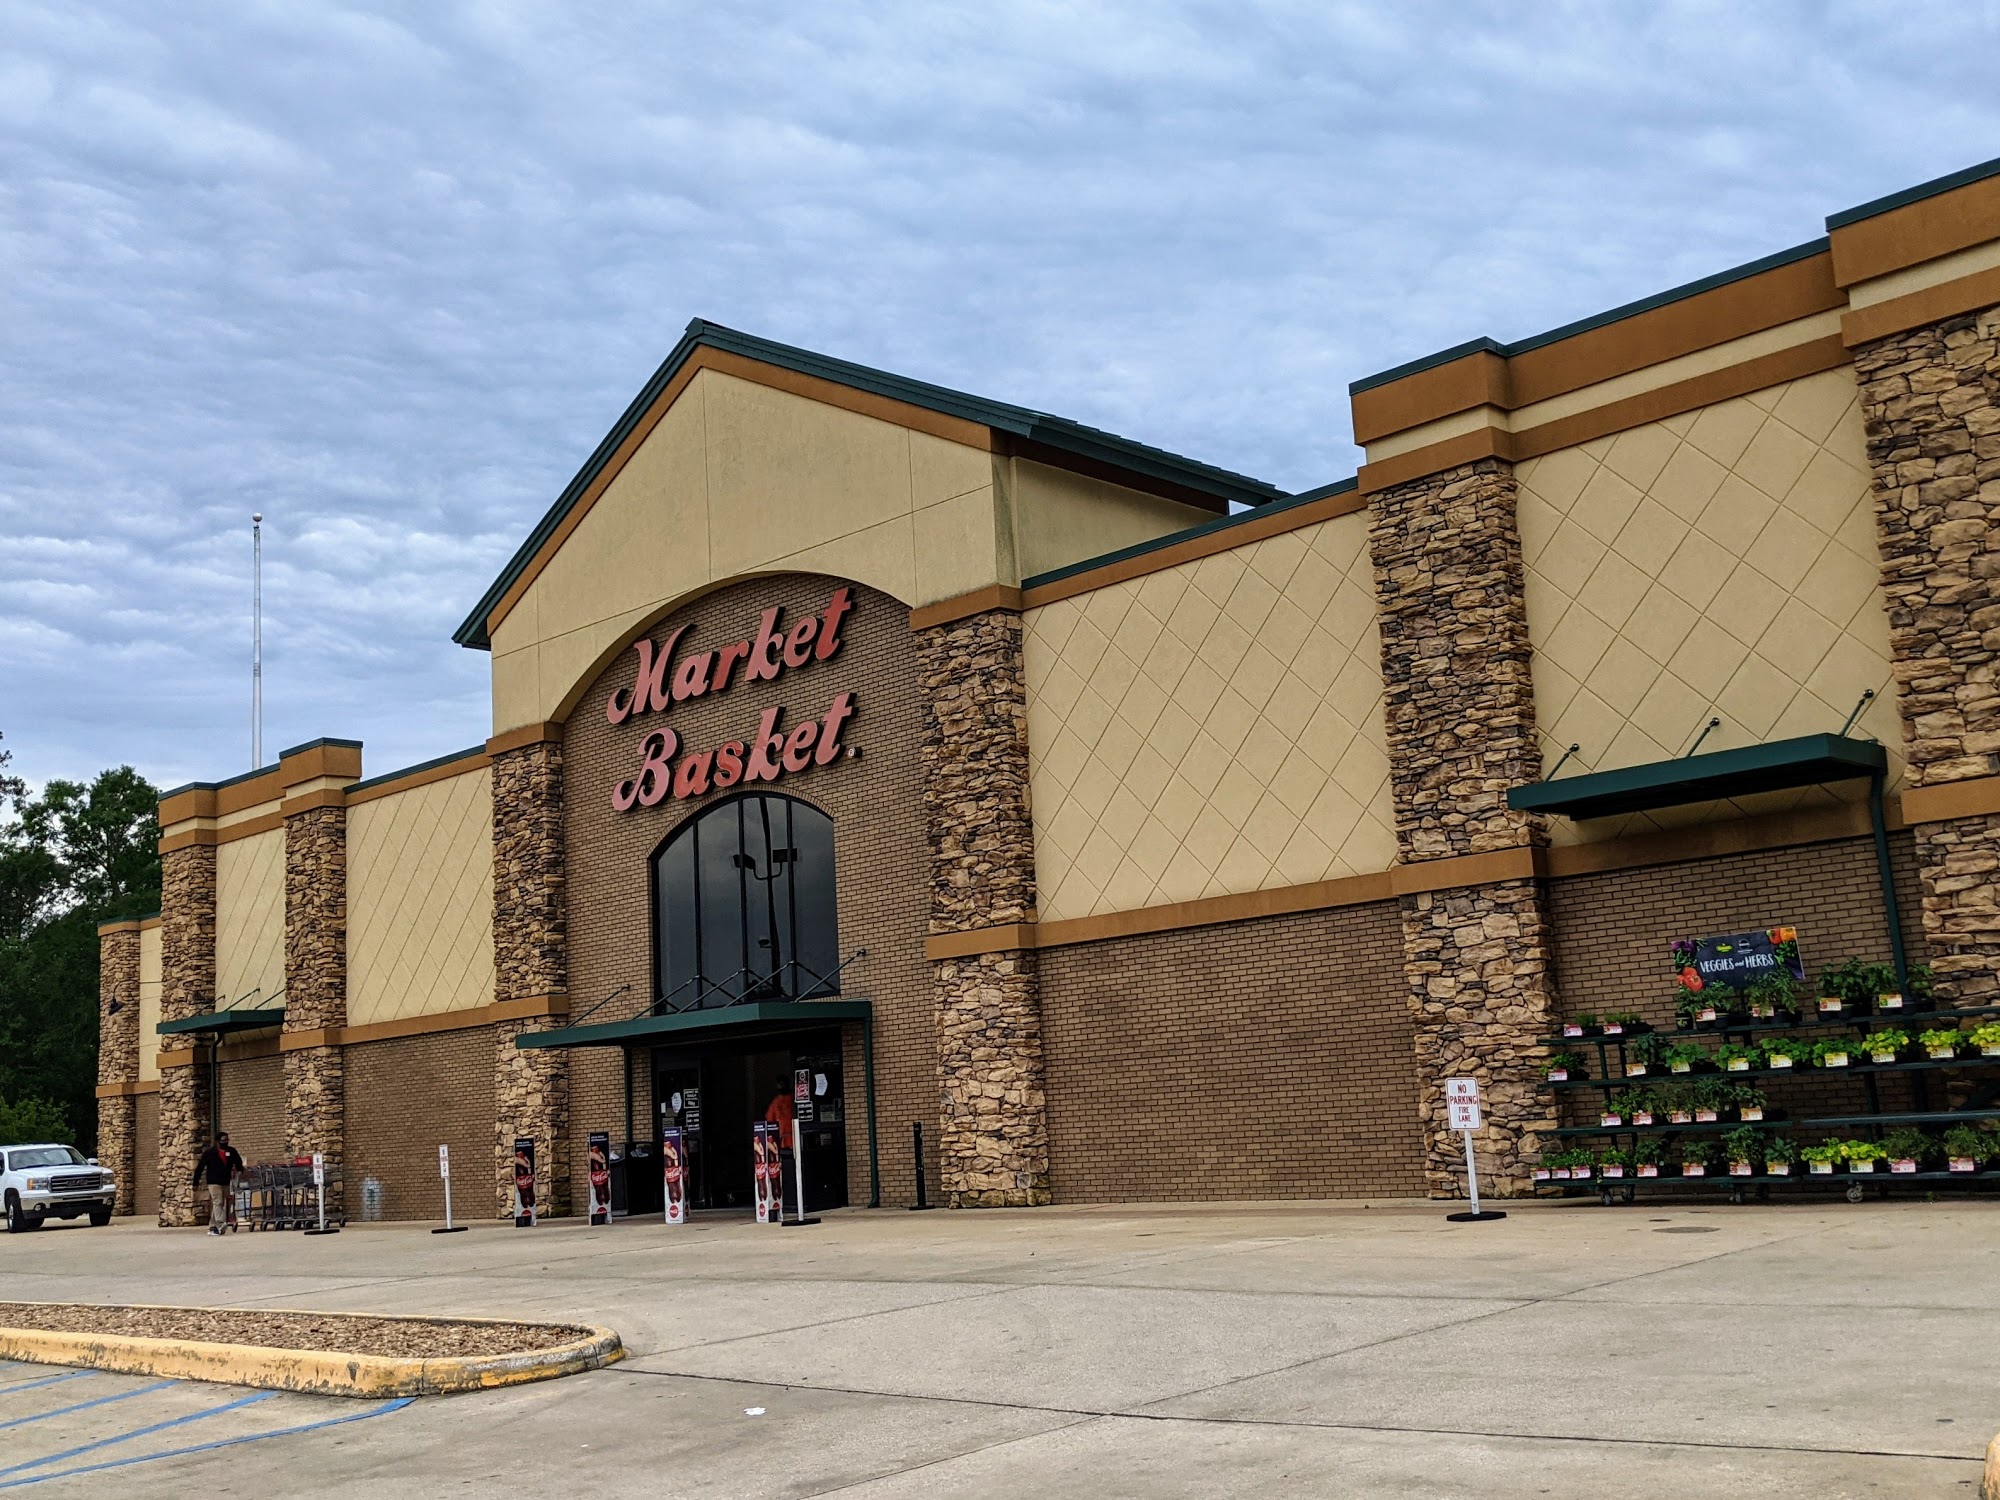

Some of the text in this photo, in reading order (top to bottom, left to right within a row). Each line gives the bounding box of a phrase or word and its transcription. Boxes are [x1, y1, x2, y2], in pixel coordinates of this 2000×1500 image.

[606, 587, 853, 725] Market
[1700, 958, 1734, 972] VEGGIES
[1744, 953, 1774, 968] HERBS
[1457, 1084, 1467, 1093] NO
[1449, 1095, 1477, 1105] PARKING
[1458, 1106, 1470, 1114] FIRE
[1458, 1114, 1471, 1122] LANE
